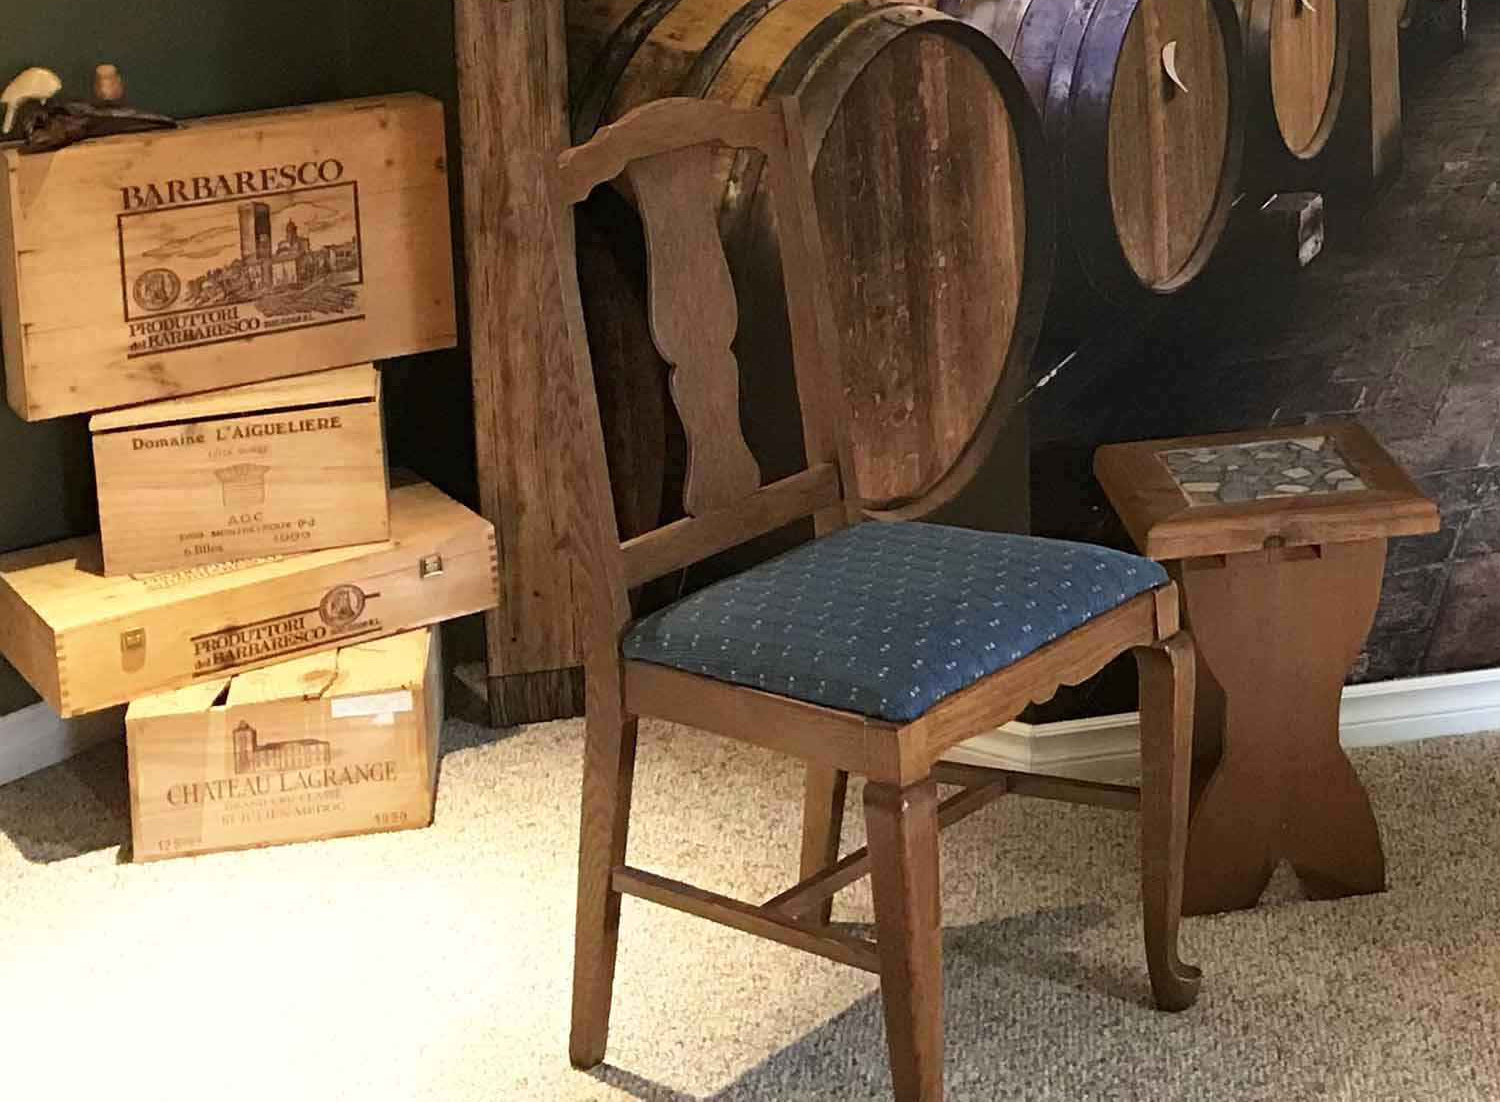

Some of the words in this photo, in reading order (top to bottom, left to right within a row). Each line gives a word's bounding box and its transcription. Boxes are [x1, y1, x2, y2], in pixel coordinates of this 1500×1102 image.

[121, 158, 344, 211] BARBARESCO
[129, 306, 239, 337] PRODUTTORI
[148, 317, 260, 348] BARBARESCO
[131, 432, 205, 451] Domaine
[194, 617, 305, 656] PRODUTTORI
[213, 626, 327, 665] BARBARESCO
[166, 774, 271, 807] CHATEAU
[280, 761, 398, 795] LAGRANGE
